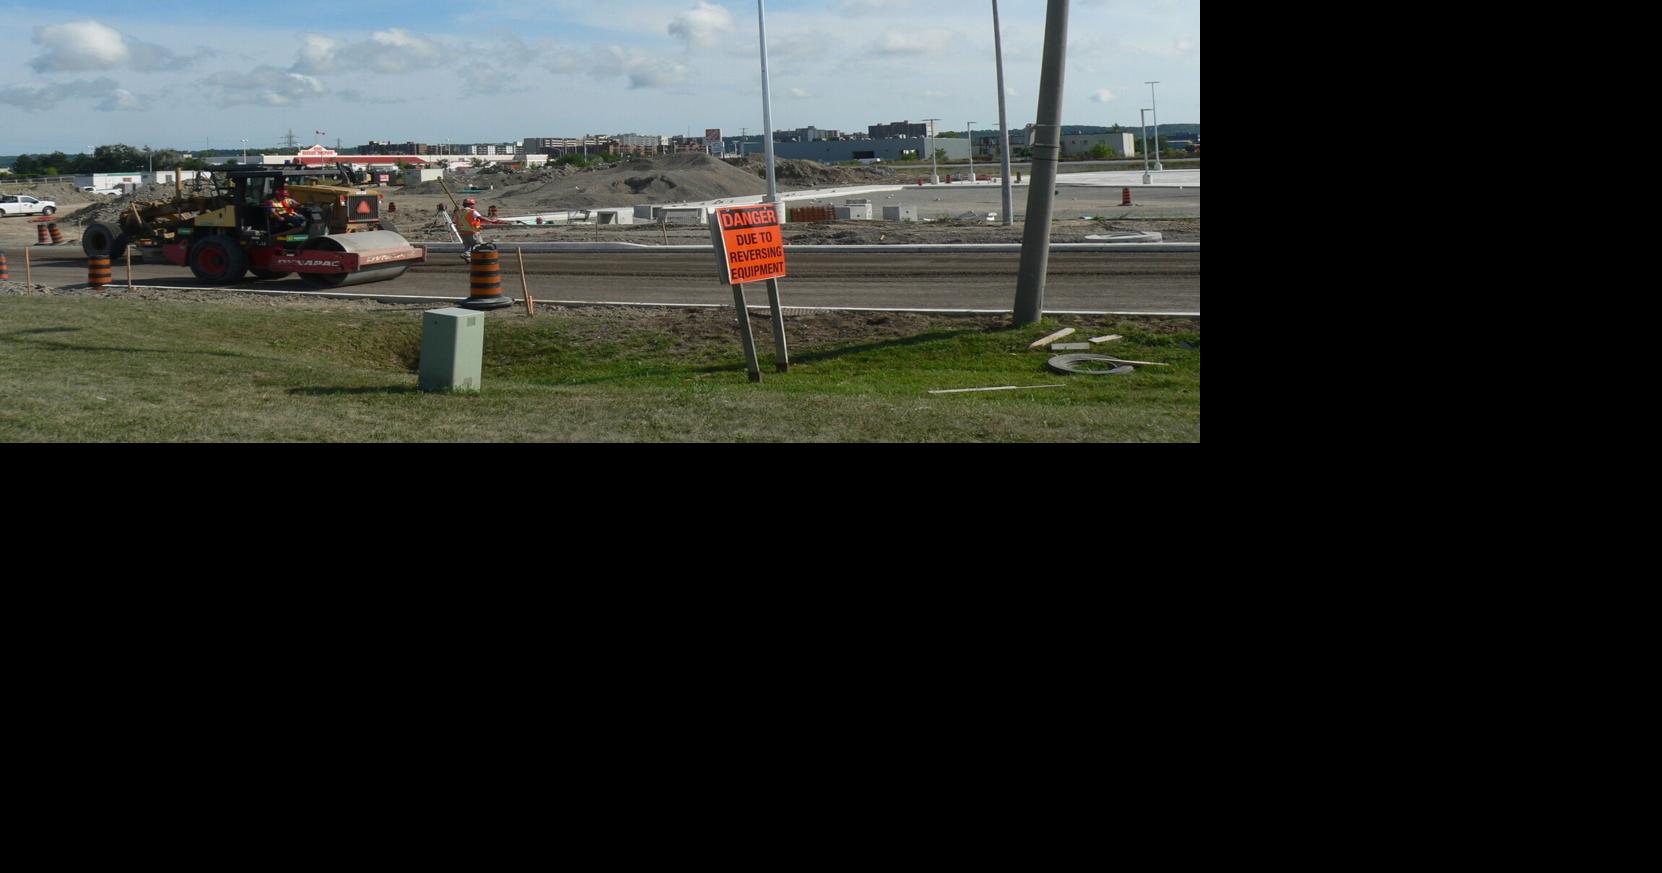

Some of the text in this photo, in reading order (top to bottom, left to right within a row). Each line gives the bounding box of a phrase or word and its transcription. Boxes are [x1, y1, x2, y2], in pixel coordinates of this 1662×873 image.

[721, 210, 776, 227] DANGER
[736, 231, 772, 246] DUE TO
[730, 246, 782, 263] REVERSING
[731, 261, 784, 280] EQUIPMENT
